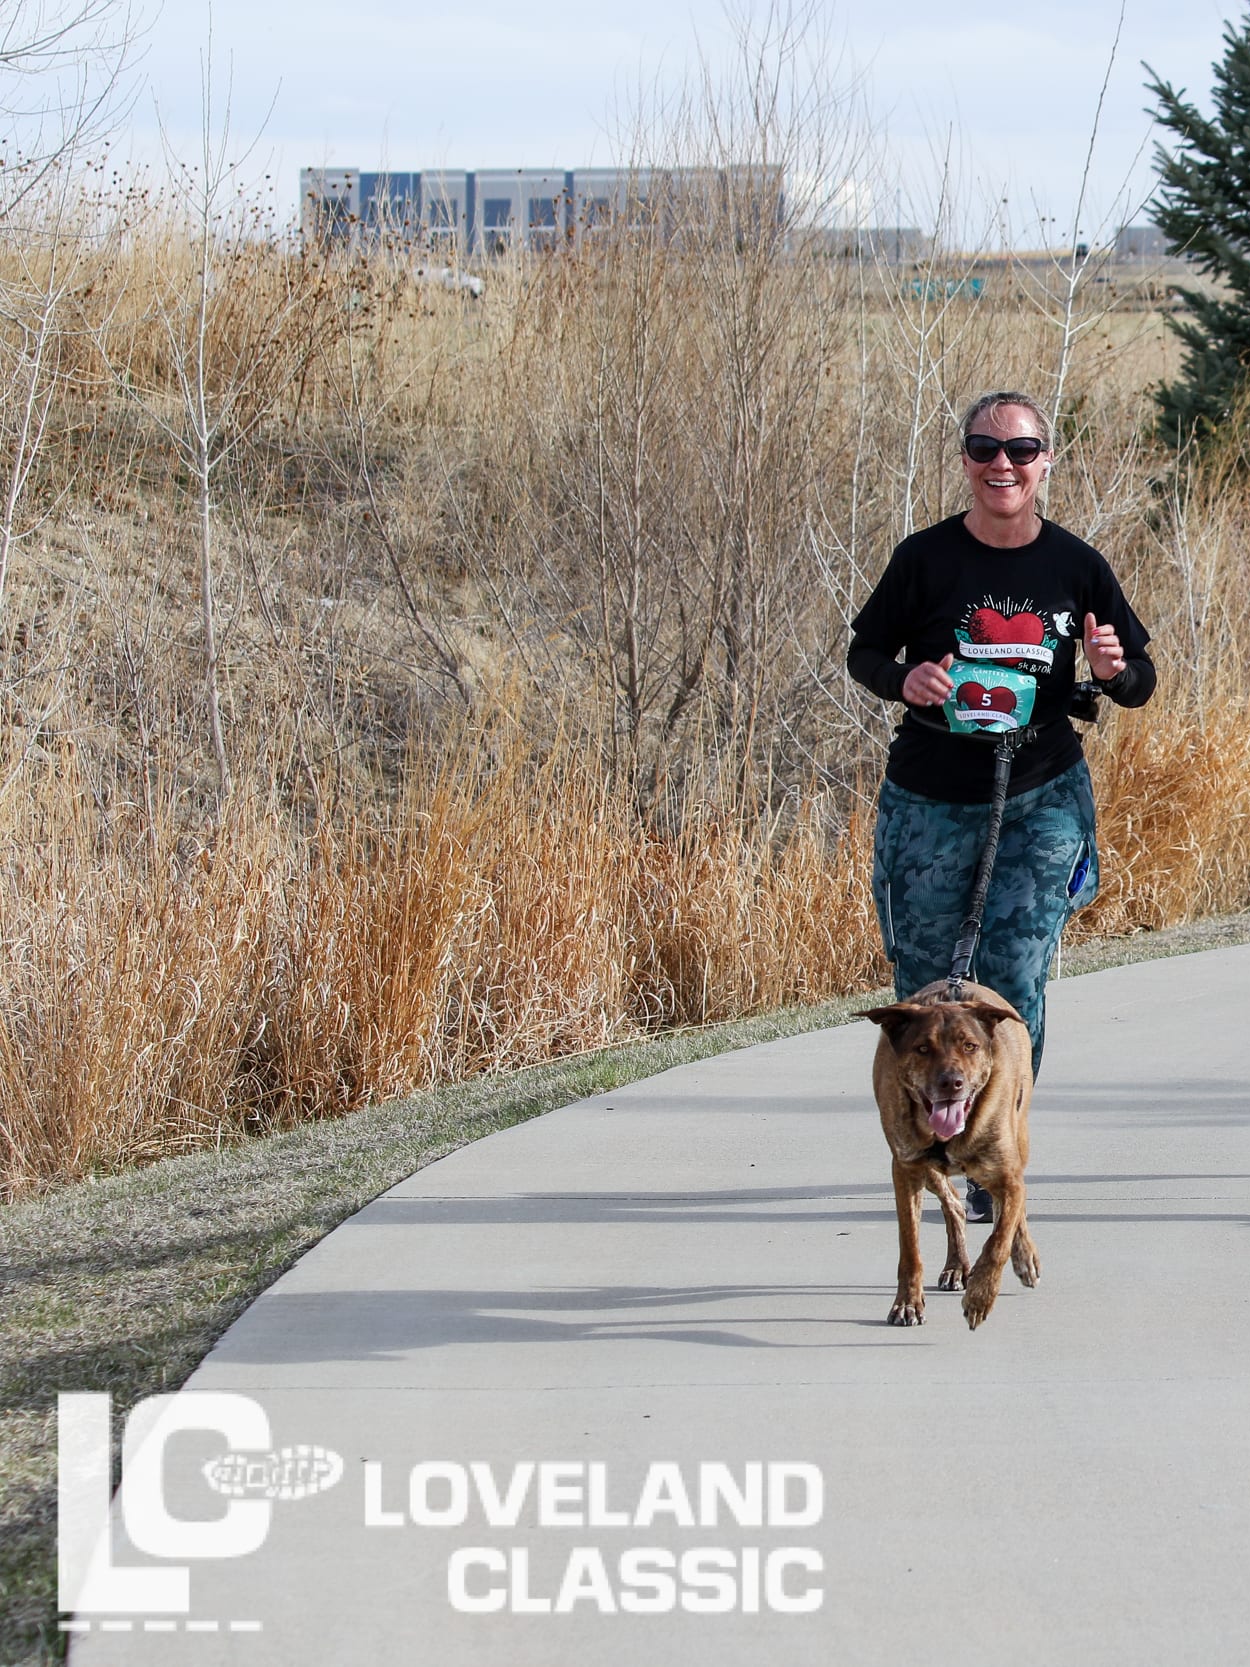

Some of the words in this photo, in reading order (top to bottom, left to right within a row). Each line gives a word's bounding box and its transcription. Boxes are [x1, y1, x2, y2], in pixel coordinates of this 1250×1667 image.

[968, 647, 1013, 655] LOVELAND
[1015, 647, 1048, 658] CLASSIC
[981, 693, 993, 707] 5
[959, 711, 990, 719] LOVELAND
